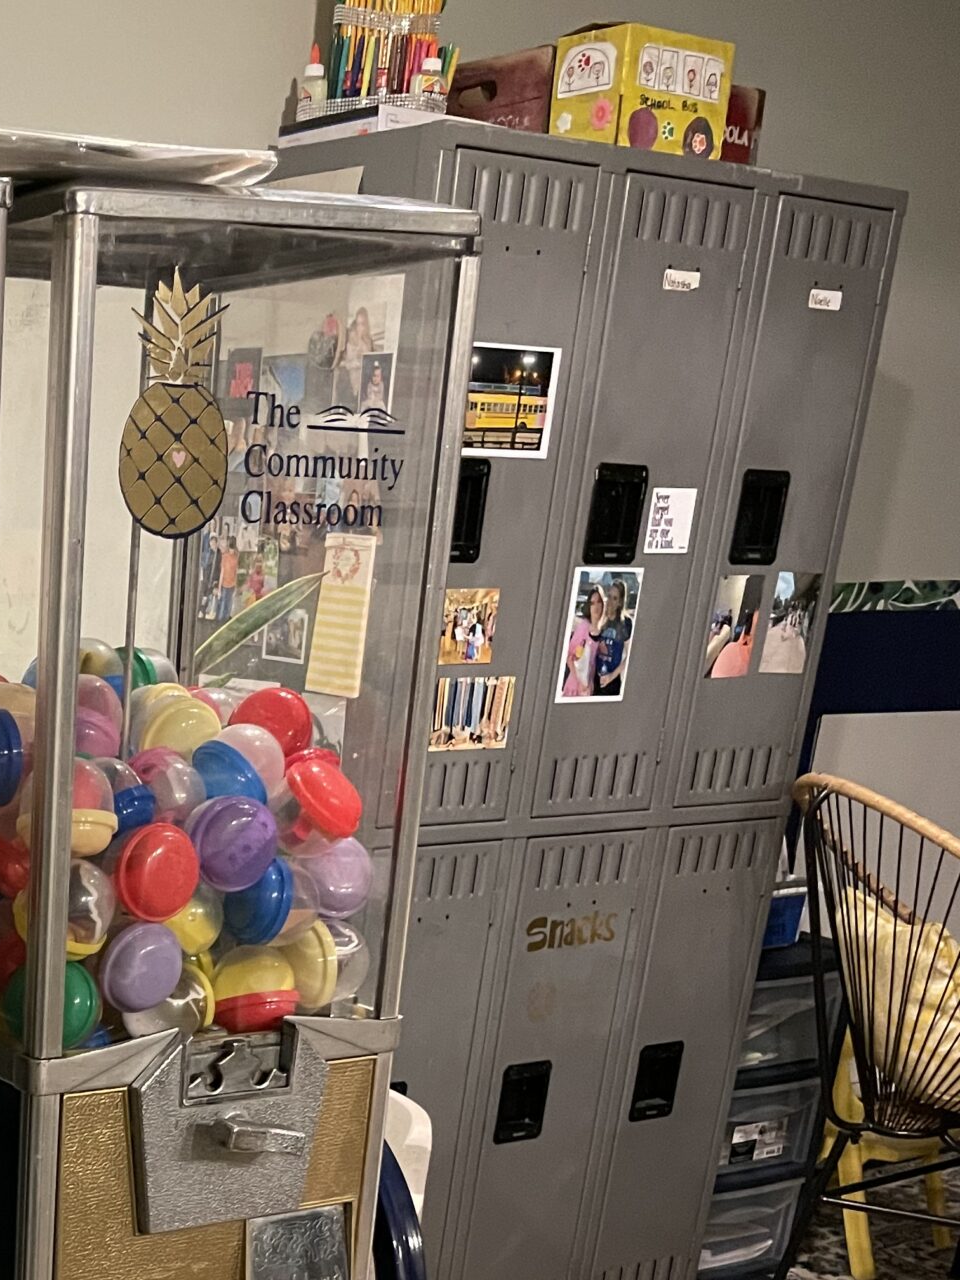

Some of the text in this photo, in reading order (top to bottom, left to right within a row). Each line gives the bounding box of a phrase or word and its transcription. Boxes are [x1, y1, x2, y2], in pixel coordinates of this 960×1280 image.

[639, 93, 699, 114] SCHOOL BUS
[724, 125, 749, 147] OLA
[247, 390, 301, 428] The
[243, 443, 405, 490] Community
[240, 490, 384, 527] Classroom
[526, 911, 618, 953] Snacks
